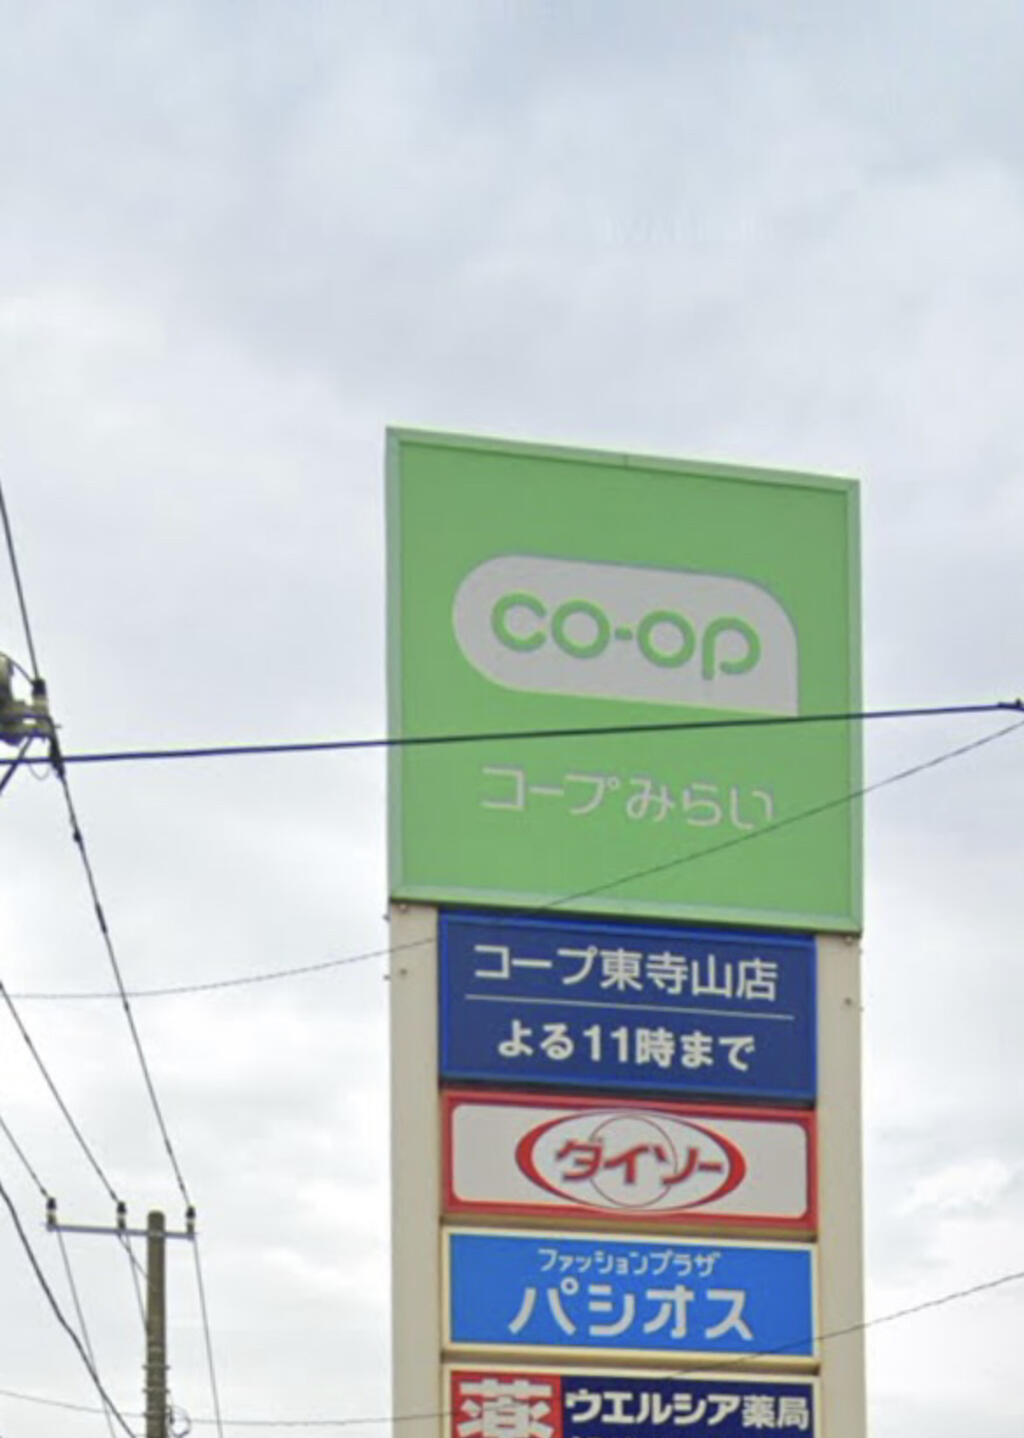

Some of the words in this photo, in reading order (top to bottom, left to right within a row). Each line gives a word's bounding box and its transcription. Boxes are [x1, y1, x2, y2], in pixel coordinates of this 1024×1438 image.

[480, 763, 776, 832] コープみらい
[473, 943, 779, 1002] コープ東寺山店
[497, 1018, 757, 1073] よる11時まで
[555, 1137, 724, 1186] ダイソー
[537, 1247, 722, 1278] ファッションプラザ
[507, 1276, 755, 1341] パシオス
[564, 1387, 810, 1432] ウエルシア薬局
